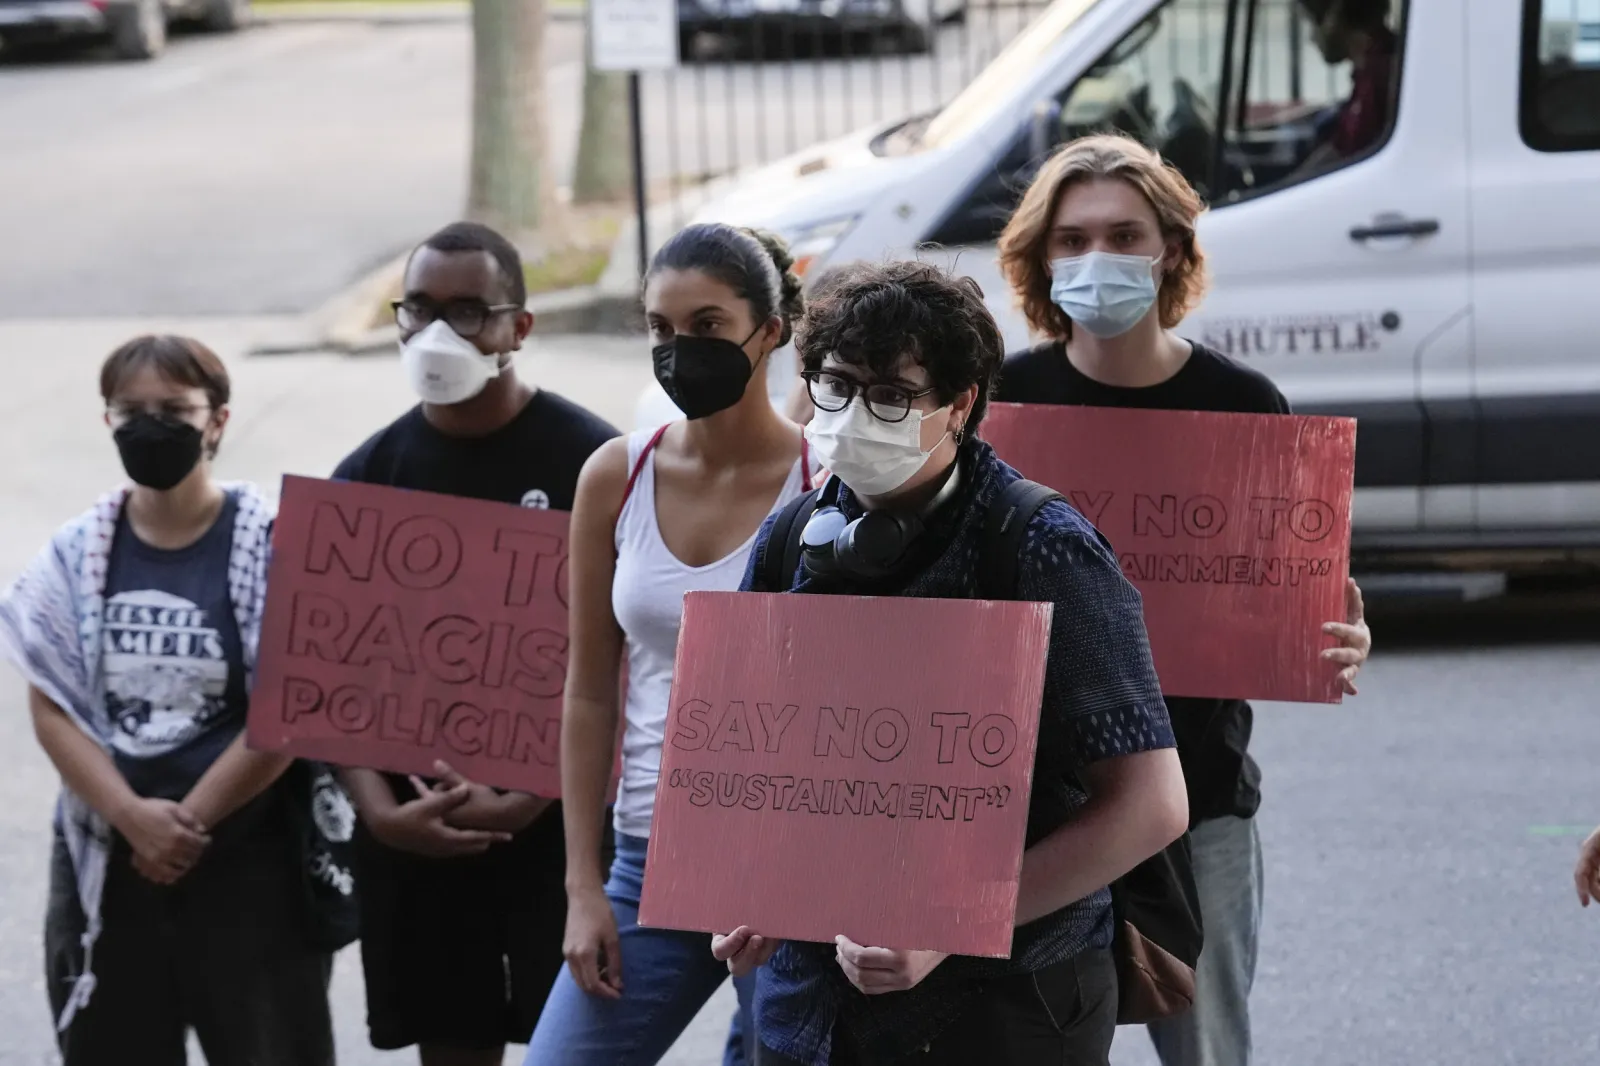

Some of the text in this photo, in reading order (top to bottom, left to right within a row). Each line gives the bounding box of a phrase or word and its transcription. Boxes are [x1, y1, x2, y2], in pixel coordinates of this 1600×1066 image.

[1202, 321, 1381, 355] SHUTTLE
[304, 500, 463, 590] NO
[1133, 493, 1228, 539] NO
[1249, 495, 1335, 542] TO
[103, 629, 224, 659] AMPUS
[286, 590, 570, 700] RACIS
[281, 675, 561, 766] POLICIN
[671, 698, 1017, 768] SAY NO TO
